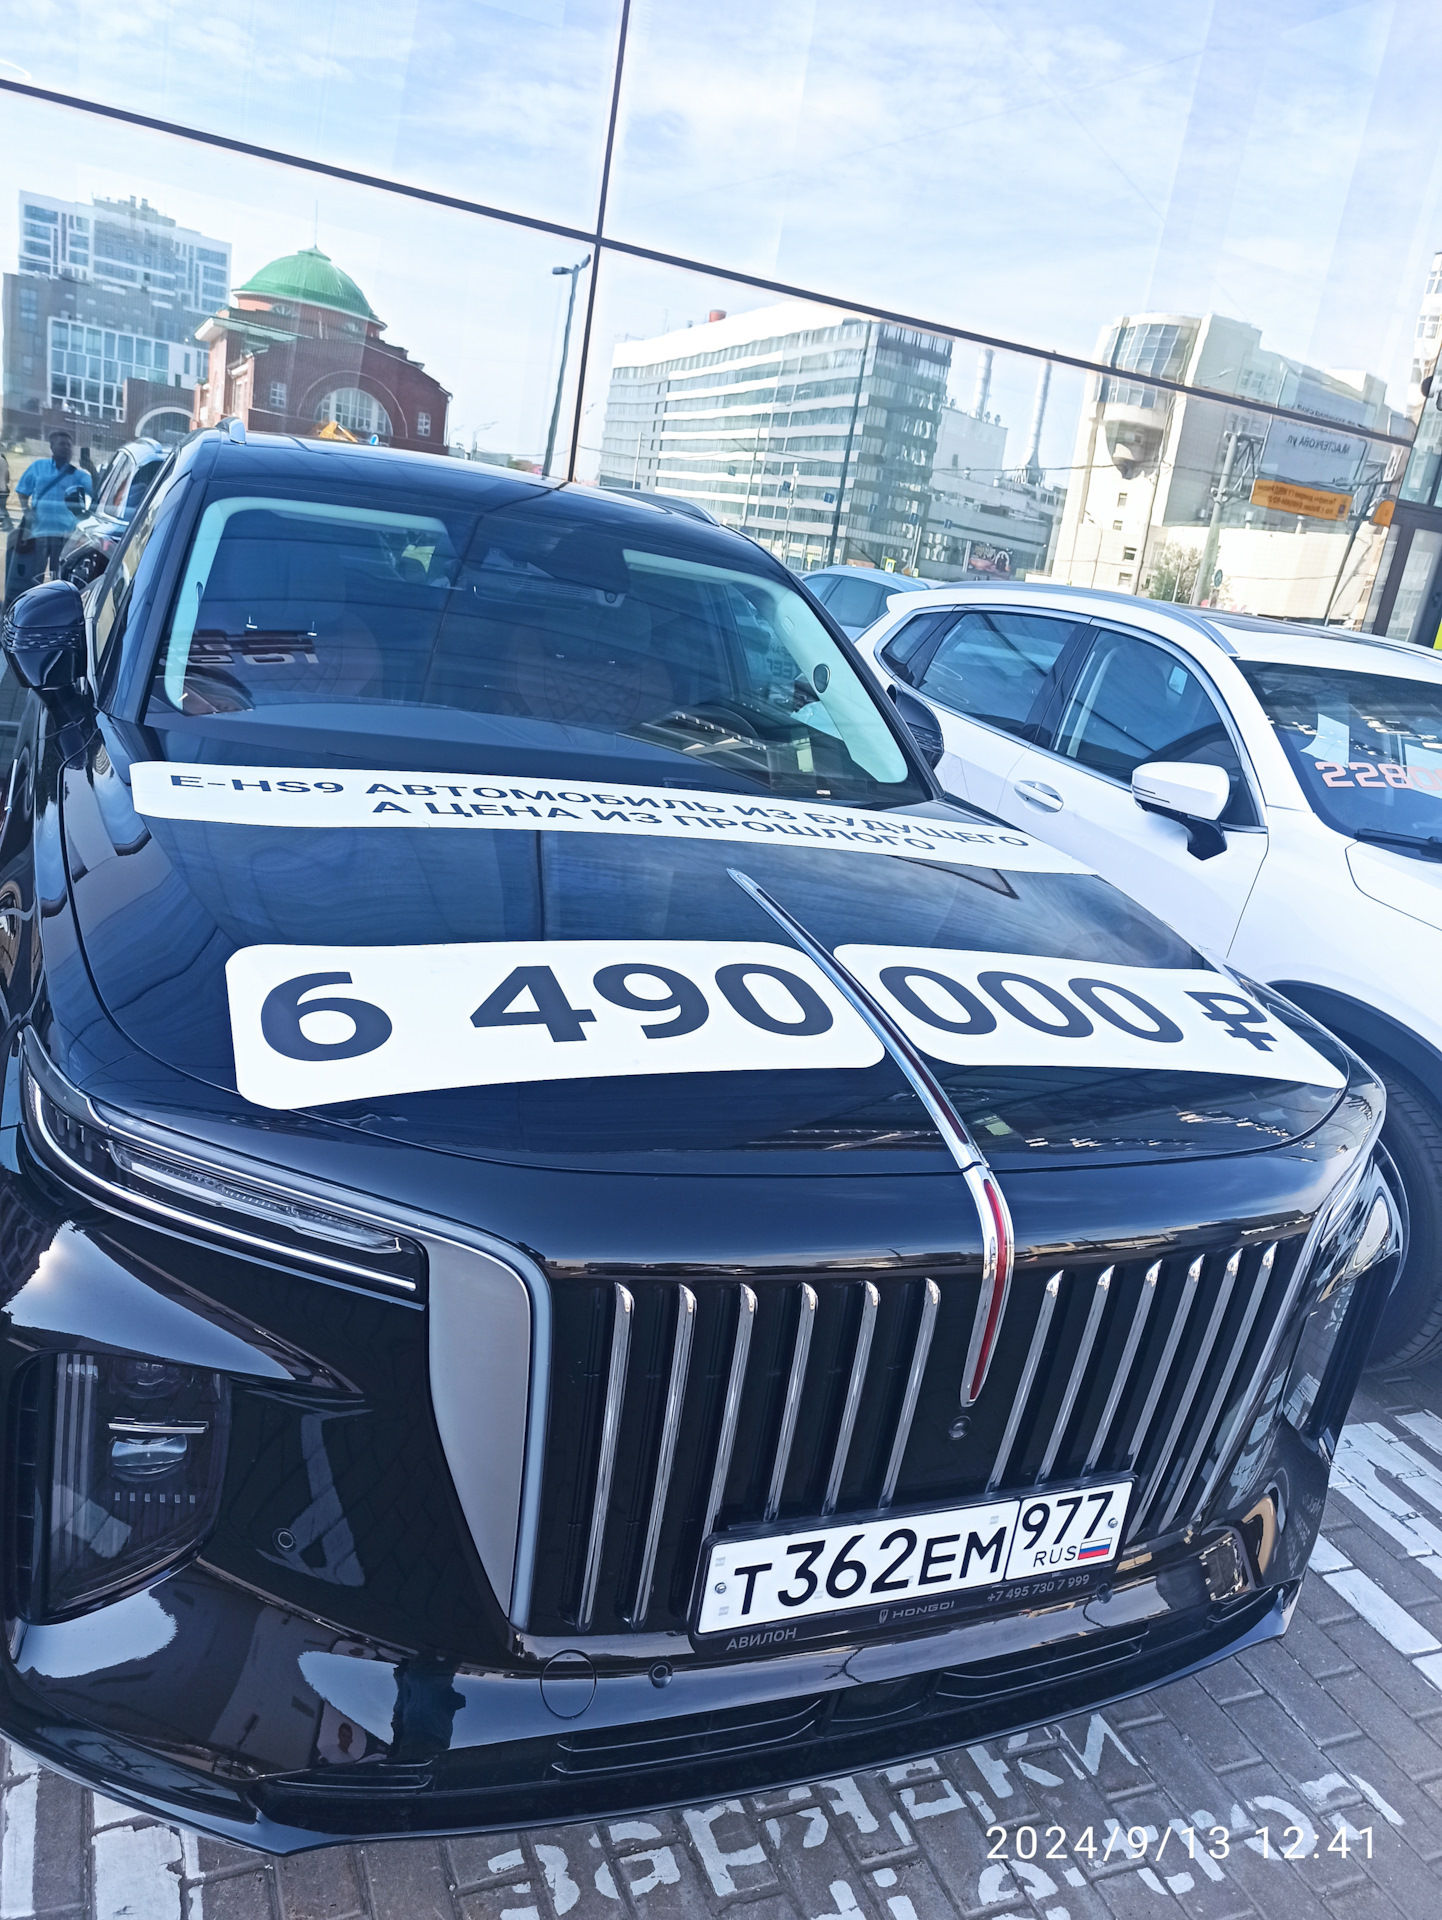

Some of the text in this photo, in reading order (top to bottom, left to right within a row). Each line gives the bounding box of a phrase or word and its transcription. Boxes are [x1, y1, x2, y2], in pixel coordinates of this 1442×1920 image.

[1315, 762, 1442, 791] 2280
[170, 774, 1030, 847] E-HS9 АВТОМОБИЛЬ ИЗ БУДУЩЕГО
[372, 801, 936, 850] А ЦЕНА ИЗ ПРОШЛОГО
[260, 971, 393, 1062] 6
[469, 963, 834, 1043] 490
[879, 966, 1184, 1043] 000
[1020, 1490, 1115, 1550] 977
[1032, 1545, 1077, 1568] RUS
[987, 1574, 1090, 1602] +7 495 730 7 999
[726, 1626, 797, 1651] АВИЛОН
